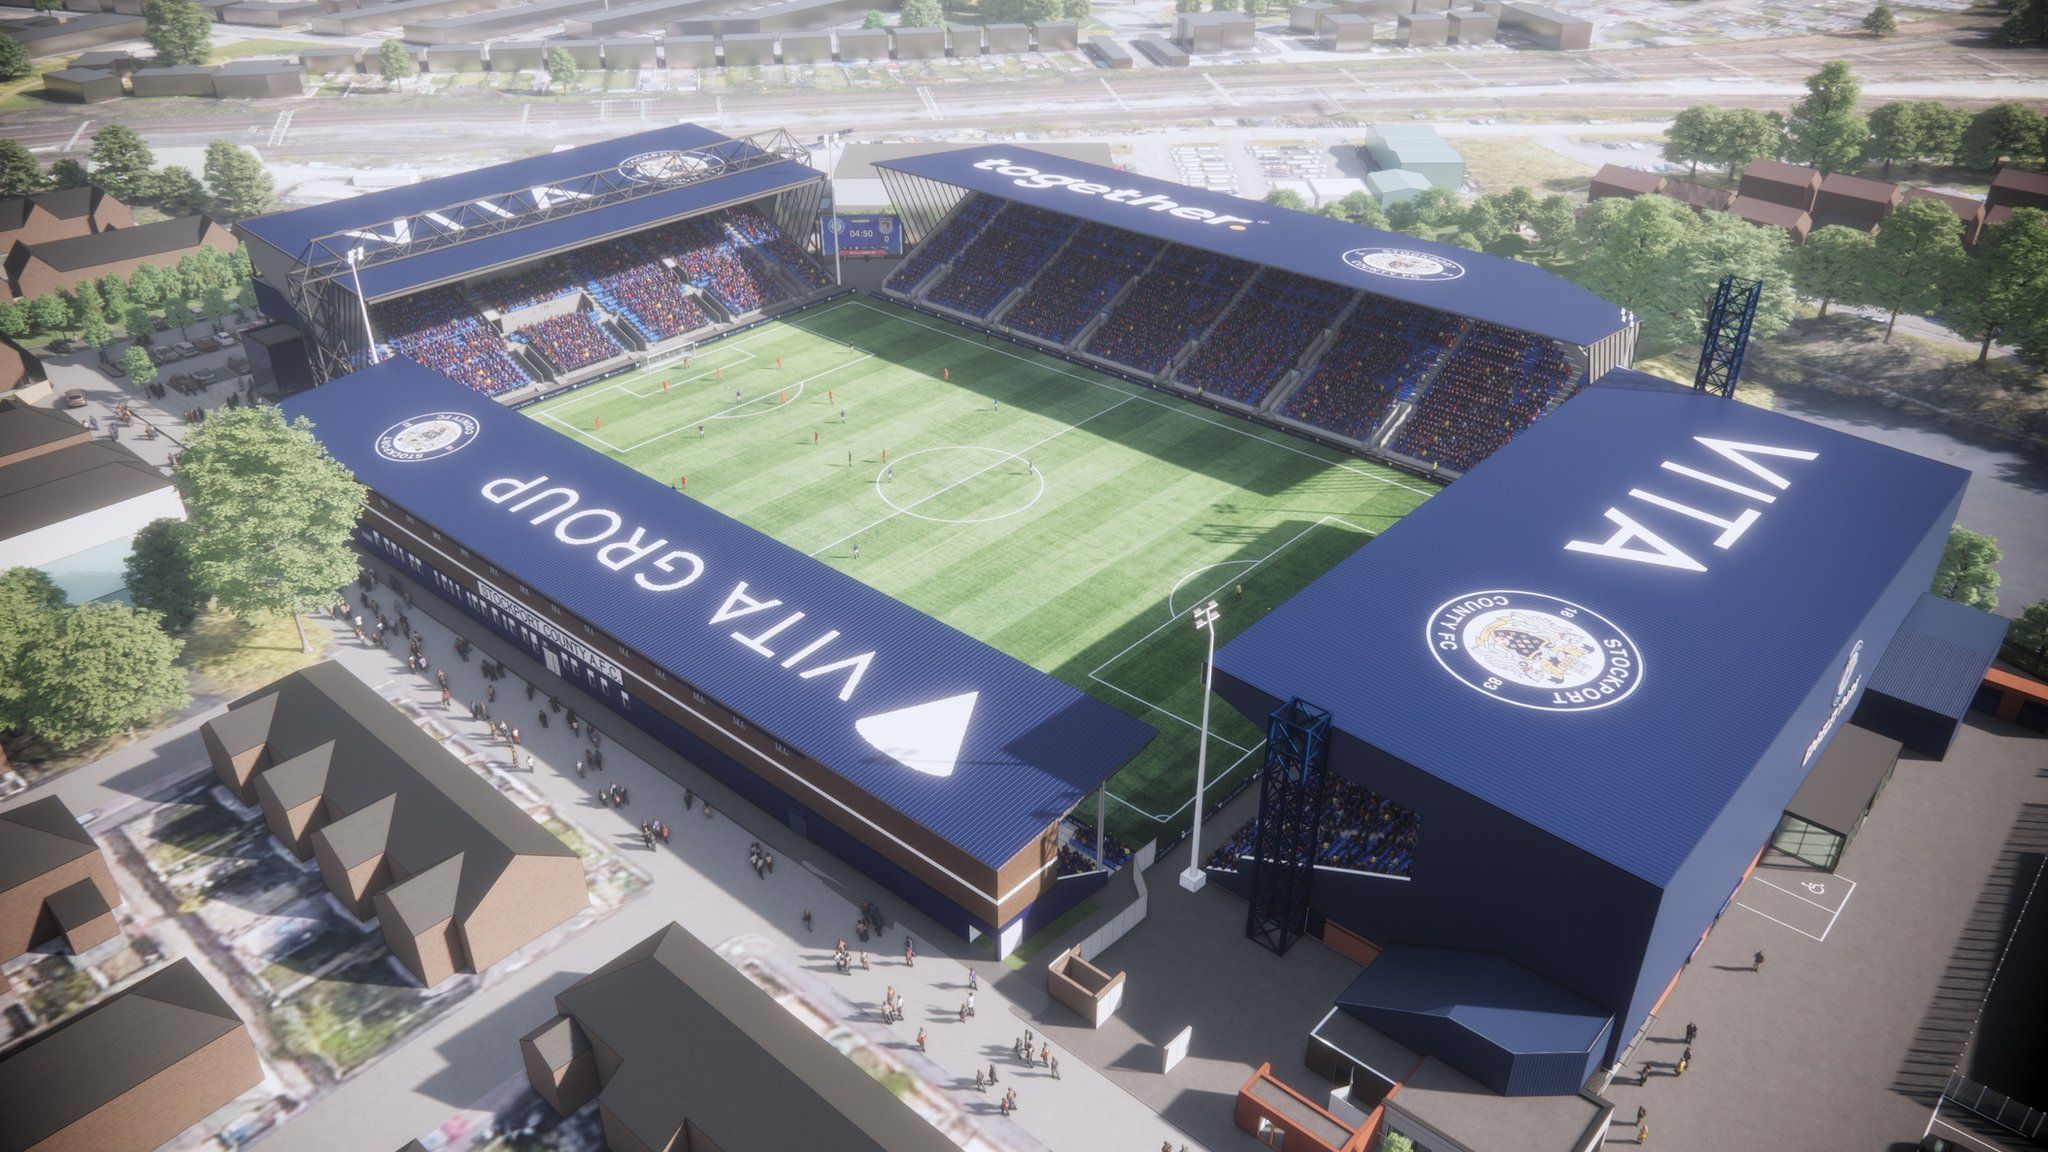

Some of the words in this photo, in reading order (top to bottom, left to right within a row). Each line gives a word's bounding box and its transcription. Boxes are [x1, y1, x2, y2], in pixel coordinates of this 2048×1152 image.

[481, 475, 705, 592] GROUP
[1564, 436, 1820, 572] VITA
[481, 584, 541, 631] STOCKPORT
[542, 625, 586, 660] COUNTY
[589, 654, 622, 683] A.F.C.
[708, 581, 877, 702] VITA
[1437, 631, 1458, 652] FC
[1439, 595, 1509, 632] COUNTY
[1560, 606, 1578, 619] 18
[1482, 676, 1503, 691] 83
[1552, 638, 1632, 705] STOCKPORT
